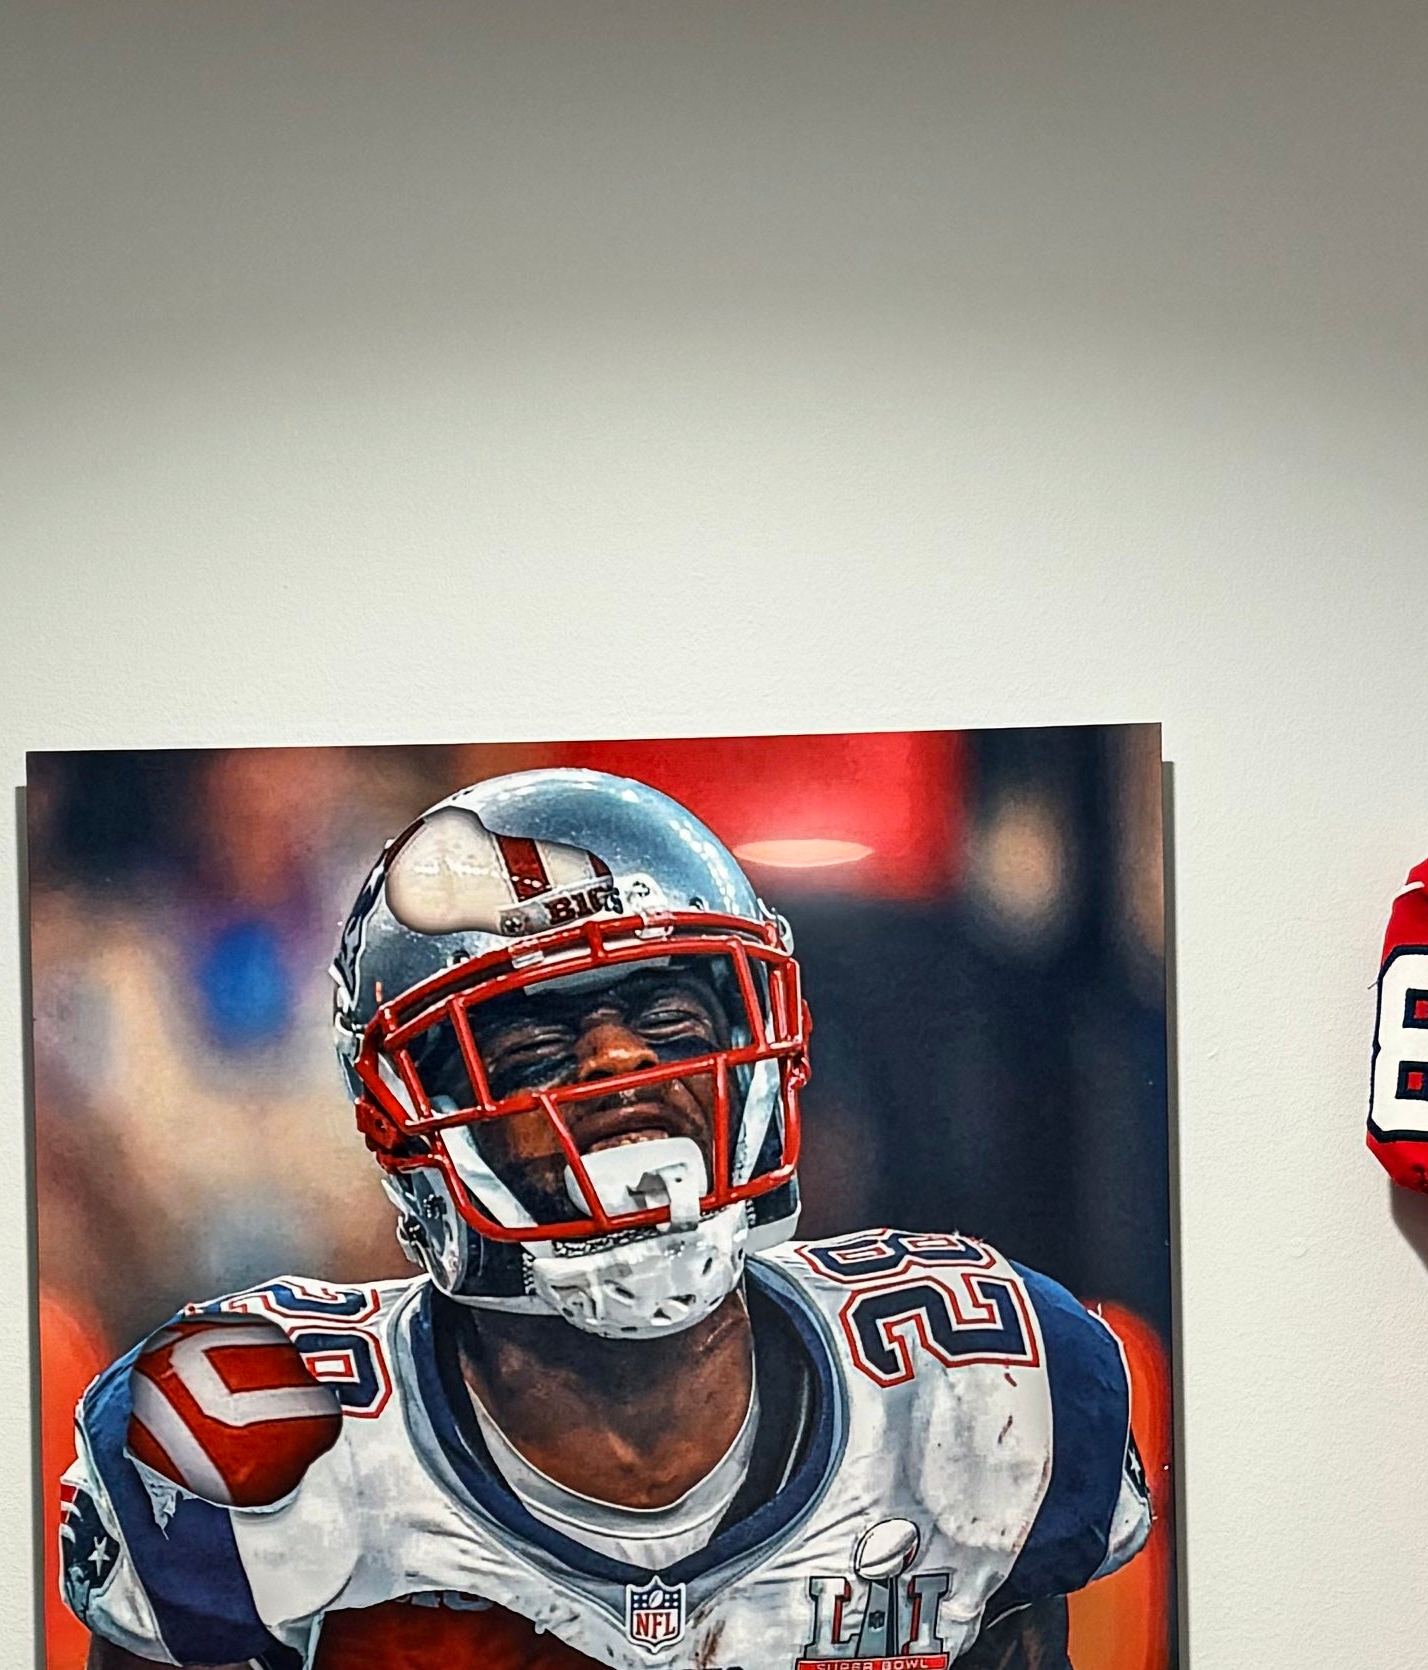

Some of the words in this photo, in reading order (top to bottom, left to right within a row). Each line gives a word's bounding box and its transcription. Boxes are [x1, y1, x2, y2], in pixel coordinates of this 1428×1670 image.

[794, 1228, 1040, 1388] 28
[635, 1612, 676, 1639] NFL
[881, 1659, 929, 1670] BOWL
